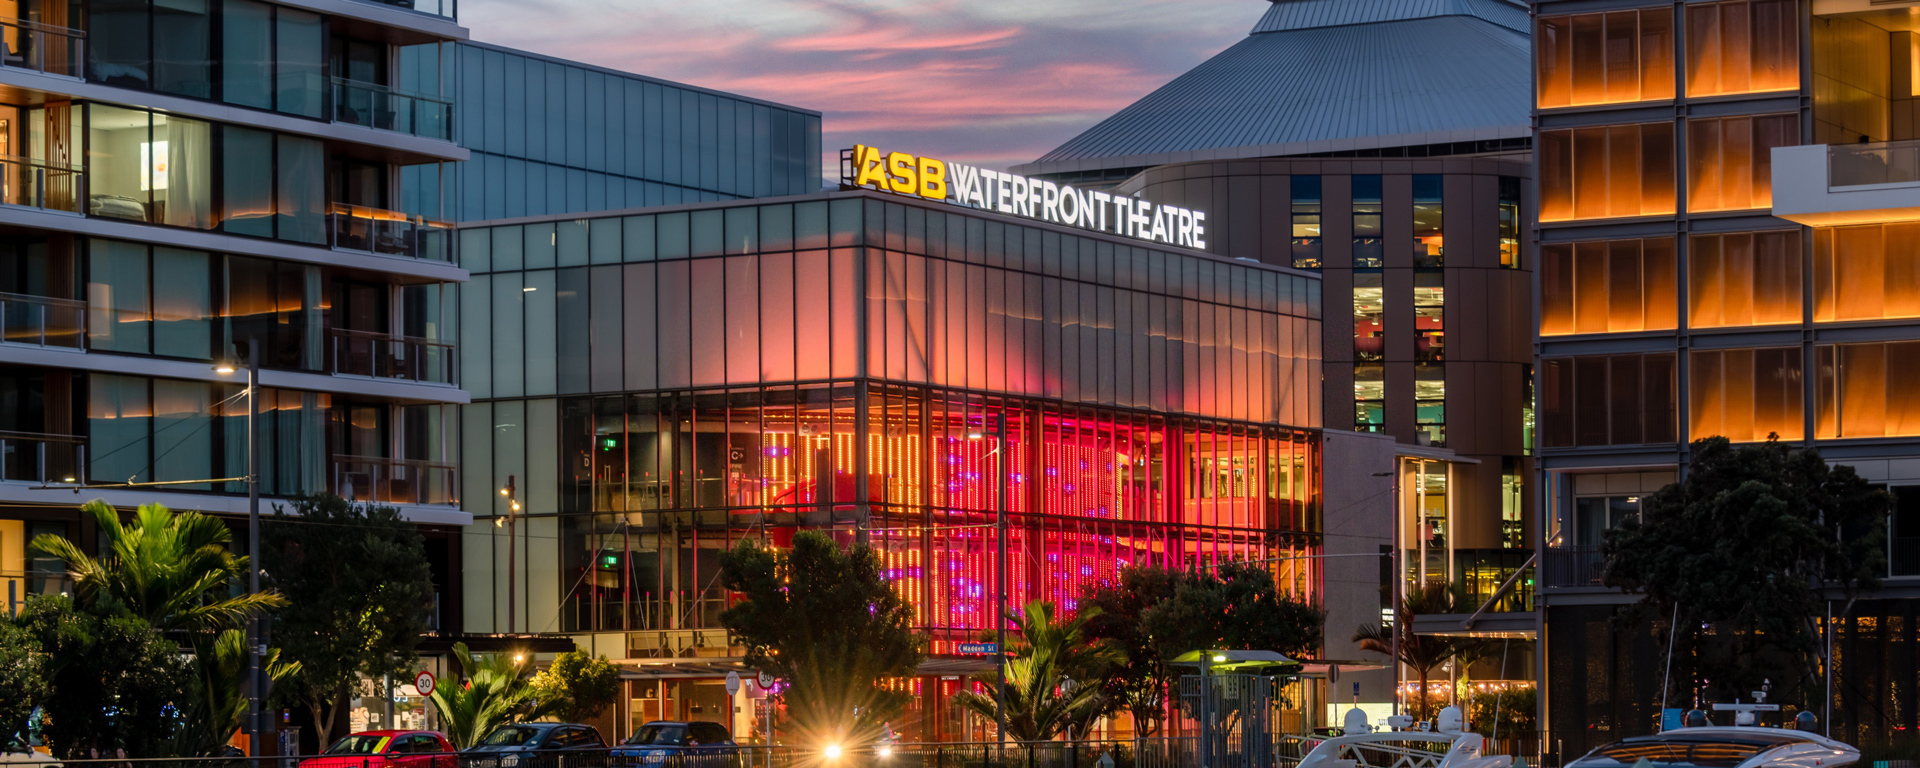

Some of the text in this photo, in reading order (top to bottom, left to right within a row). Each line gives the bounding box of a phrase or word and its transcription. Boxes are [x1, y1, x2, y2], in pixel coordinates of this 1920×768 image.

[853, 144, 1205, 250] ASB WATERFRONT THEATRE
[419, 678, 431, 688] 30
